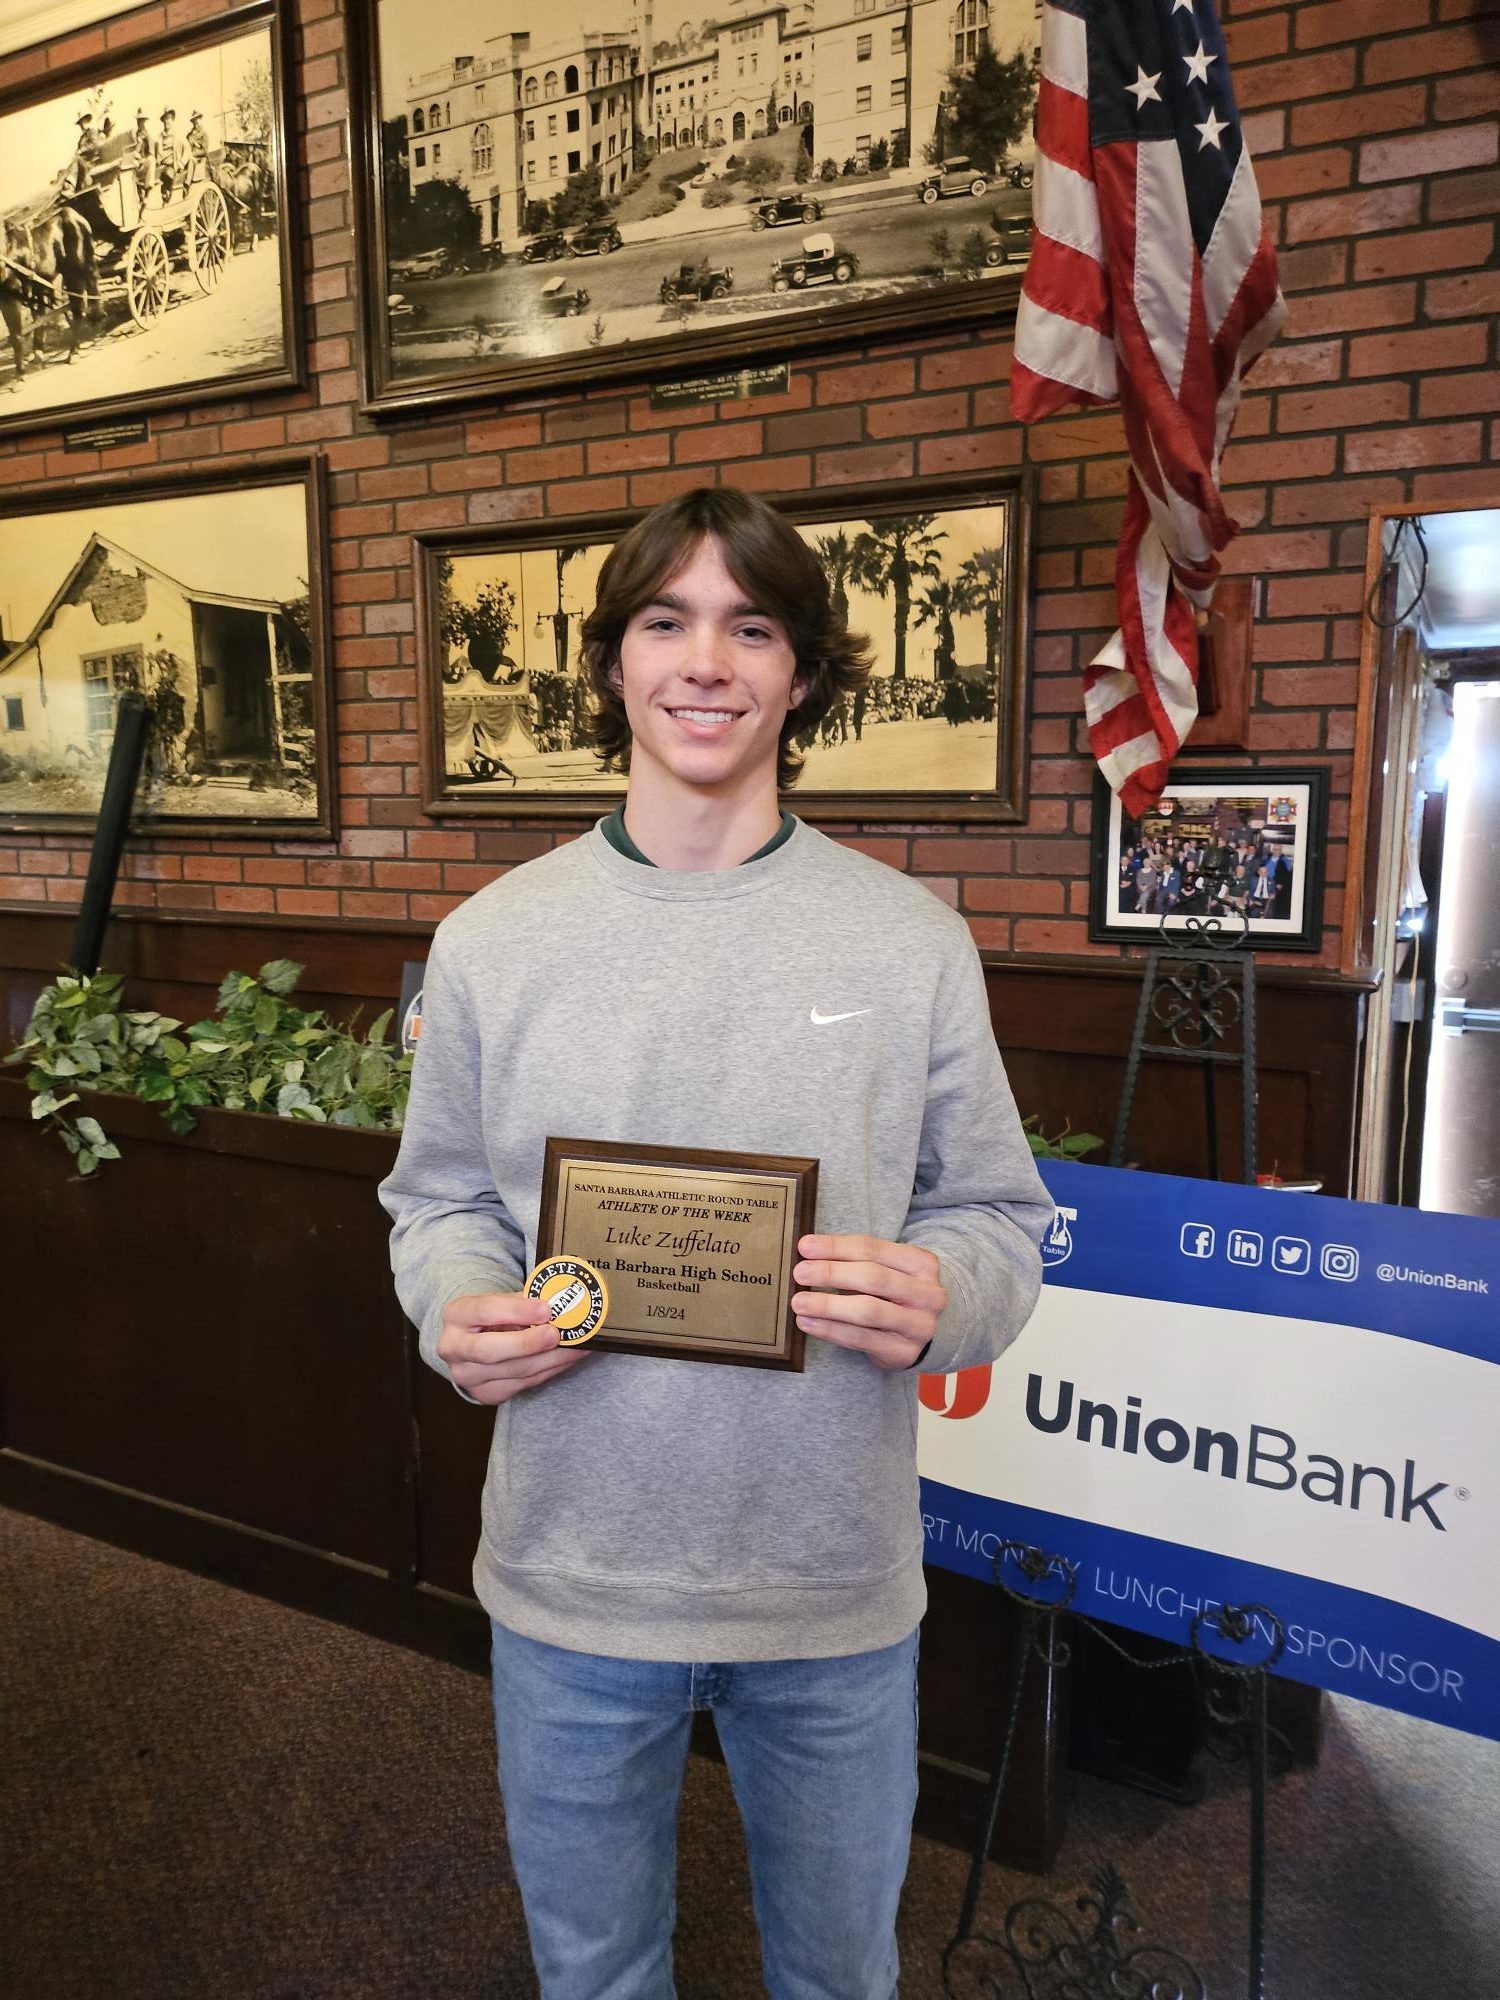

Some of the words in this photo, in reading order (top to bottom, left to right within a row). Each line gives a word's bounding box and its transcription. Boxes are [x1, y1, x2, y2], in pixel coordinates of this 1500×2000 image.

[574, 1183, 606, 1194] SANTA
[608, 1186, 654, 1198] BARBARA
[656, 1190, 706, 1202] ATHLETIC
[708, 1195, 744, 1206] ROUND
[746, 1198, 779, 1209] TABLE
[597, 1200, 659, 1214] ATHLETE
[661, 1205, 680, 1216] OF
[683, 1207, 711, 1219] THE
[714, 1209, 753, 1223] WEEK
[605, 1225, 652, 1246] Luke
[655, 1229, 741, 1258] Zuffelato
[616, 1258, 676, 1276] Barbara
[680, 1264, 717, 1282] High
[721, 1269, 772, 1286] School
[637, 1277, 700, 1294] Basketball
[1376, 1263, 1489, 1294] @UnionBank
[567, 1328, 586, 1340] the
[582, 1288, 602, 1330] WEEK
[646, 1305, 686, 1320] 1/8/24
[1026, 1373, 1450, 1532] UnionBank
[956, 1524, 1081, 1583] MONAY
[1286, 1625, 1464, 1702] SPONSOR
